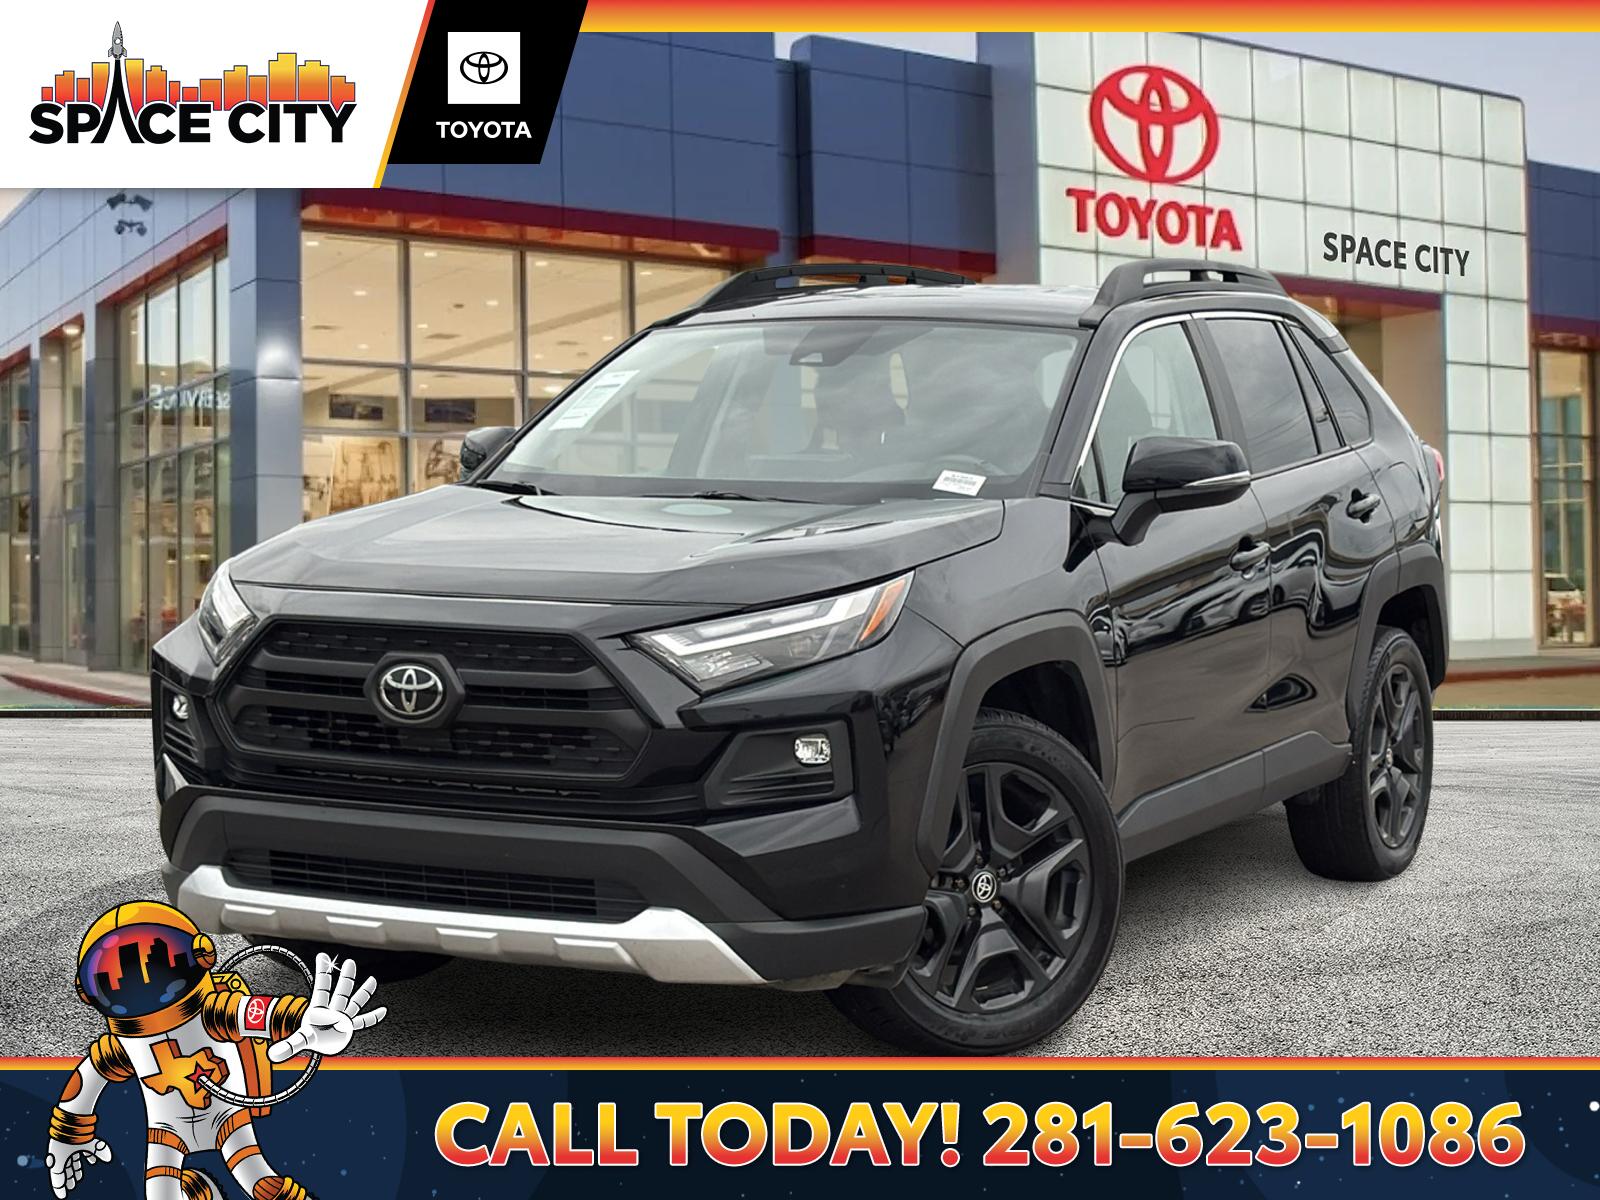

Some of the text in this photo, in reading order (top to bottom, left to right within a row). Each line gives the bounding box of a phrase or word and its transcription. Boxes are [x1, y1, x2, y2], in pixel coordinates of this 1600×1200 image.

[1066, 187, 1242, 251] TOYOTA
[1323, 232, 1470, 277] SPACE CITY
